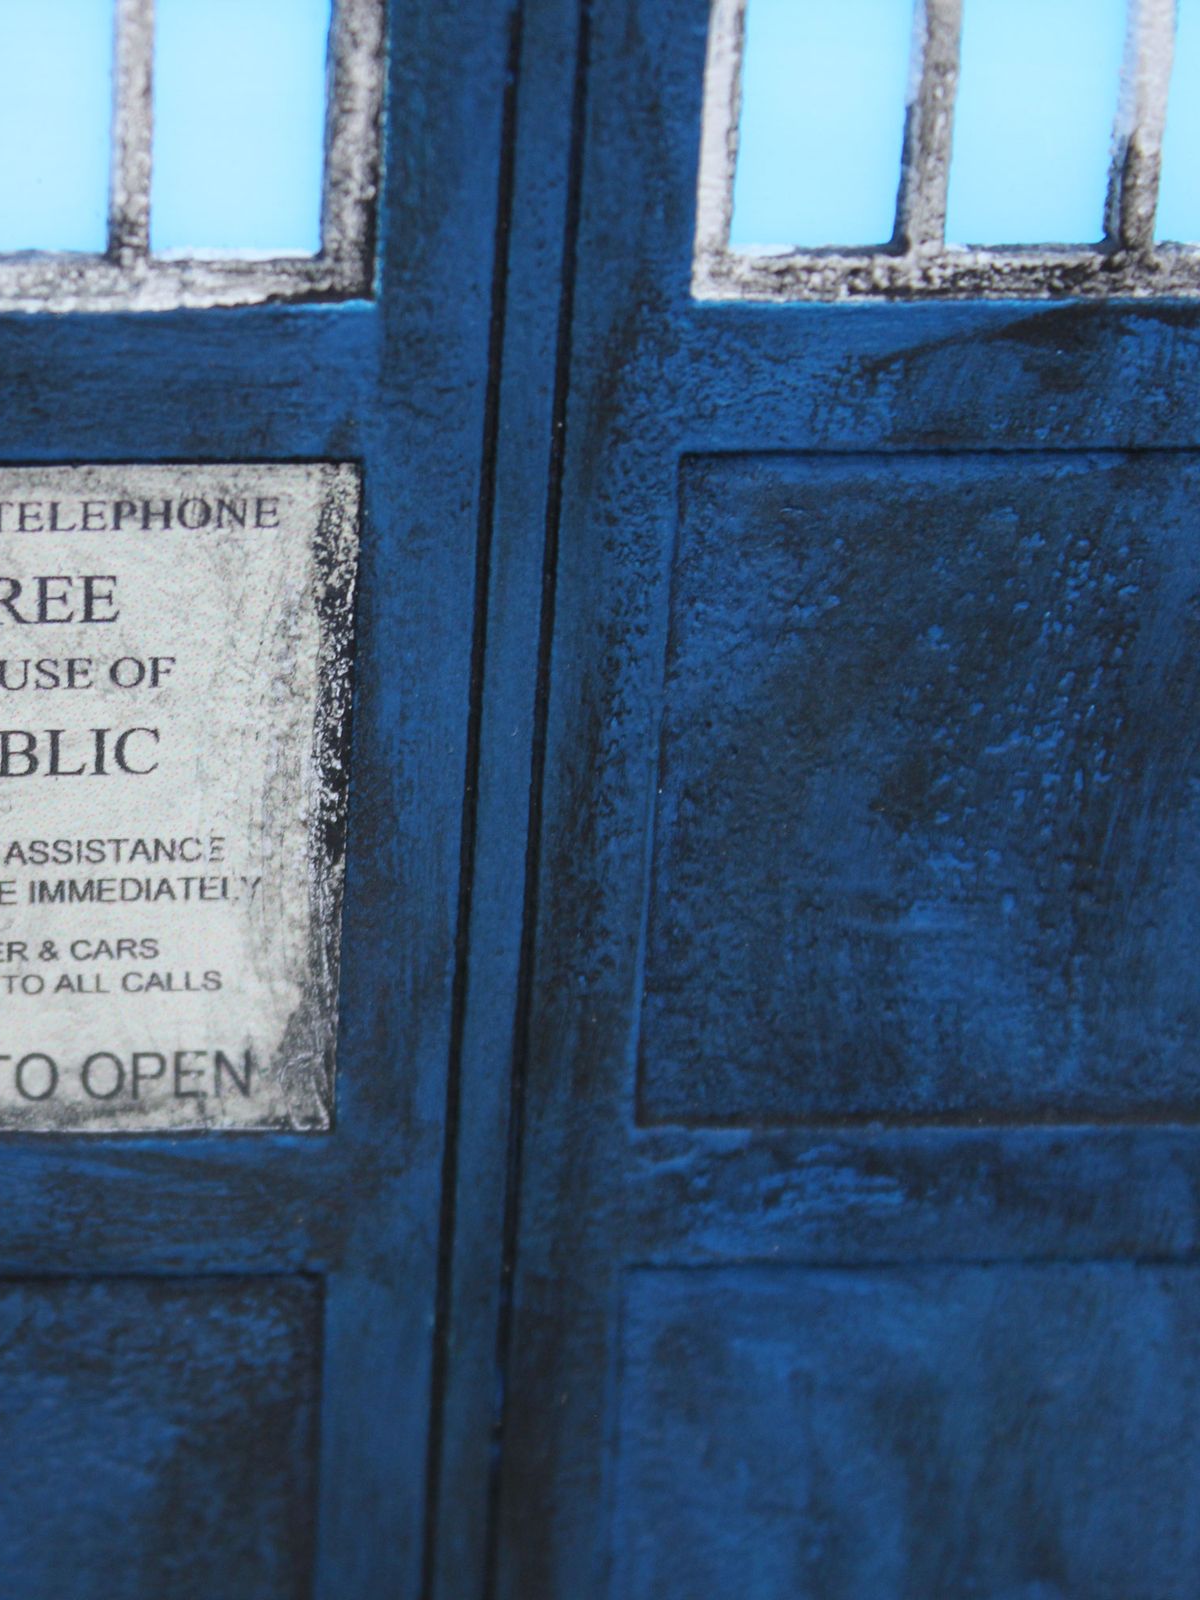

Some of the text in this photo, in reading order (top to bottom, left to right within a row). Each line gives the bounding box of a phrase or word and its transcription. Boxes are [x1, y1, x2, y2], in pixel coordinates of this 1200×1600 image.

[109, 656, 176, 689] OF
[4, 835, 226, 867] ASSISTANCE
[41, 941, 59, 962] &
[68, 938, 160, 961] CARS
[3, 974, 45, 997] TO
[53, 973, 111, 995] ALL
[120, 970, 222, 994] CALLS
[80, 1049, 254, 1100] OPEN
